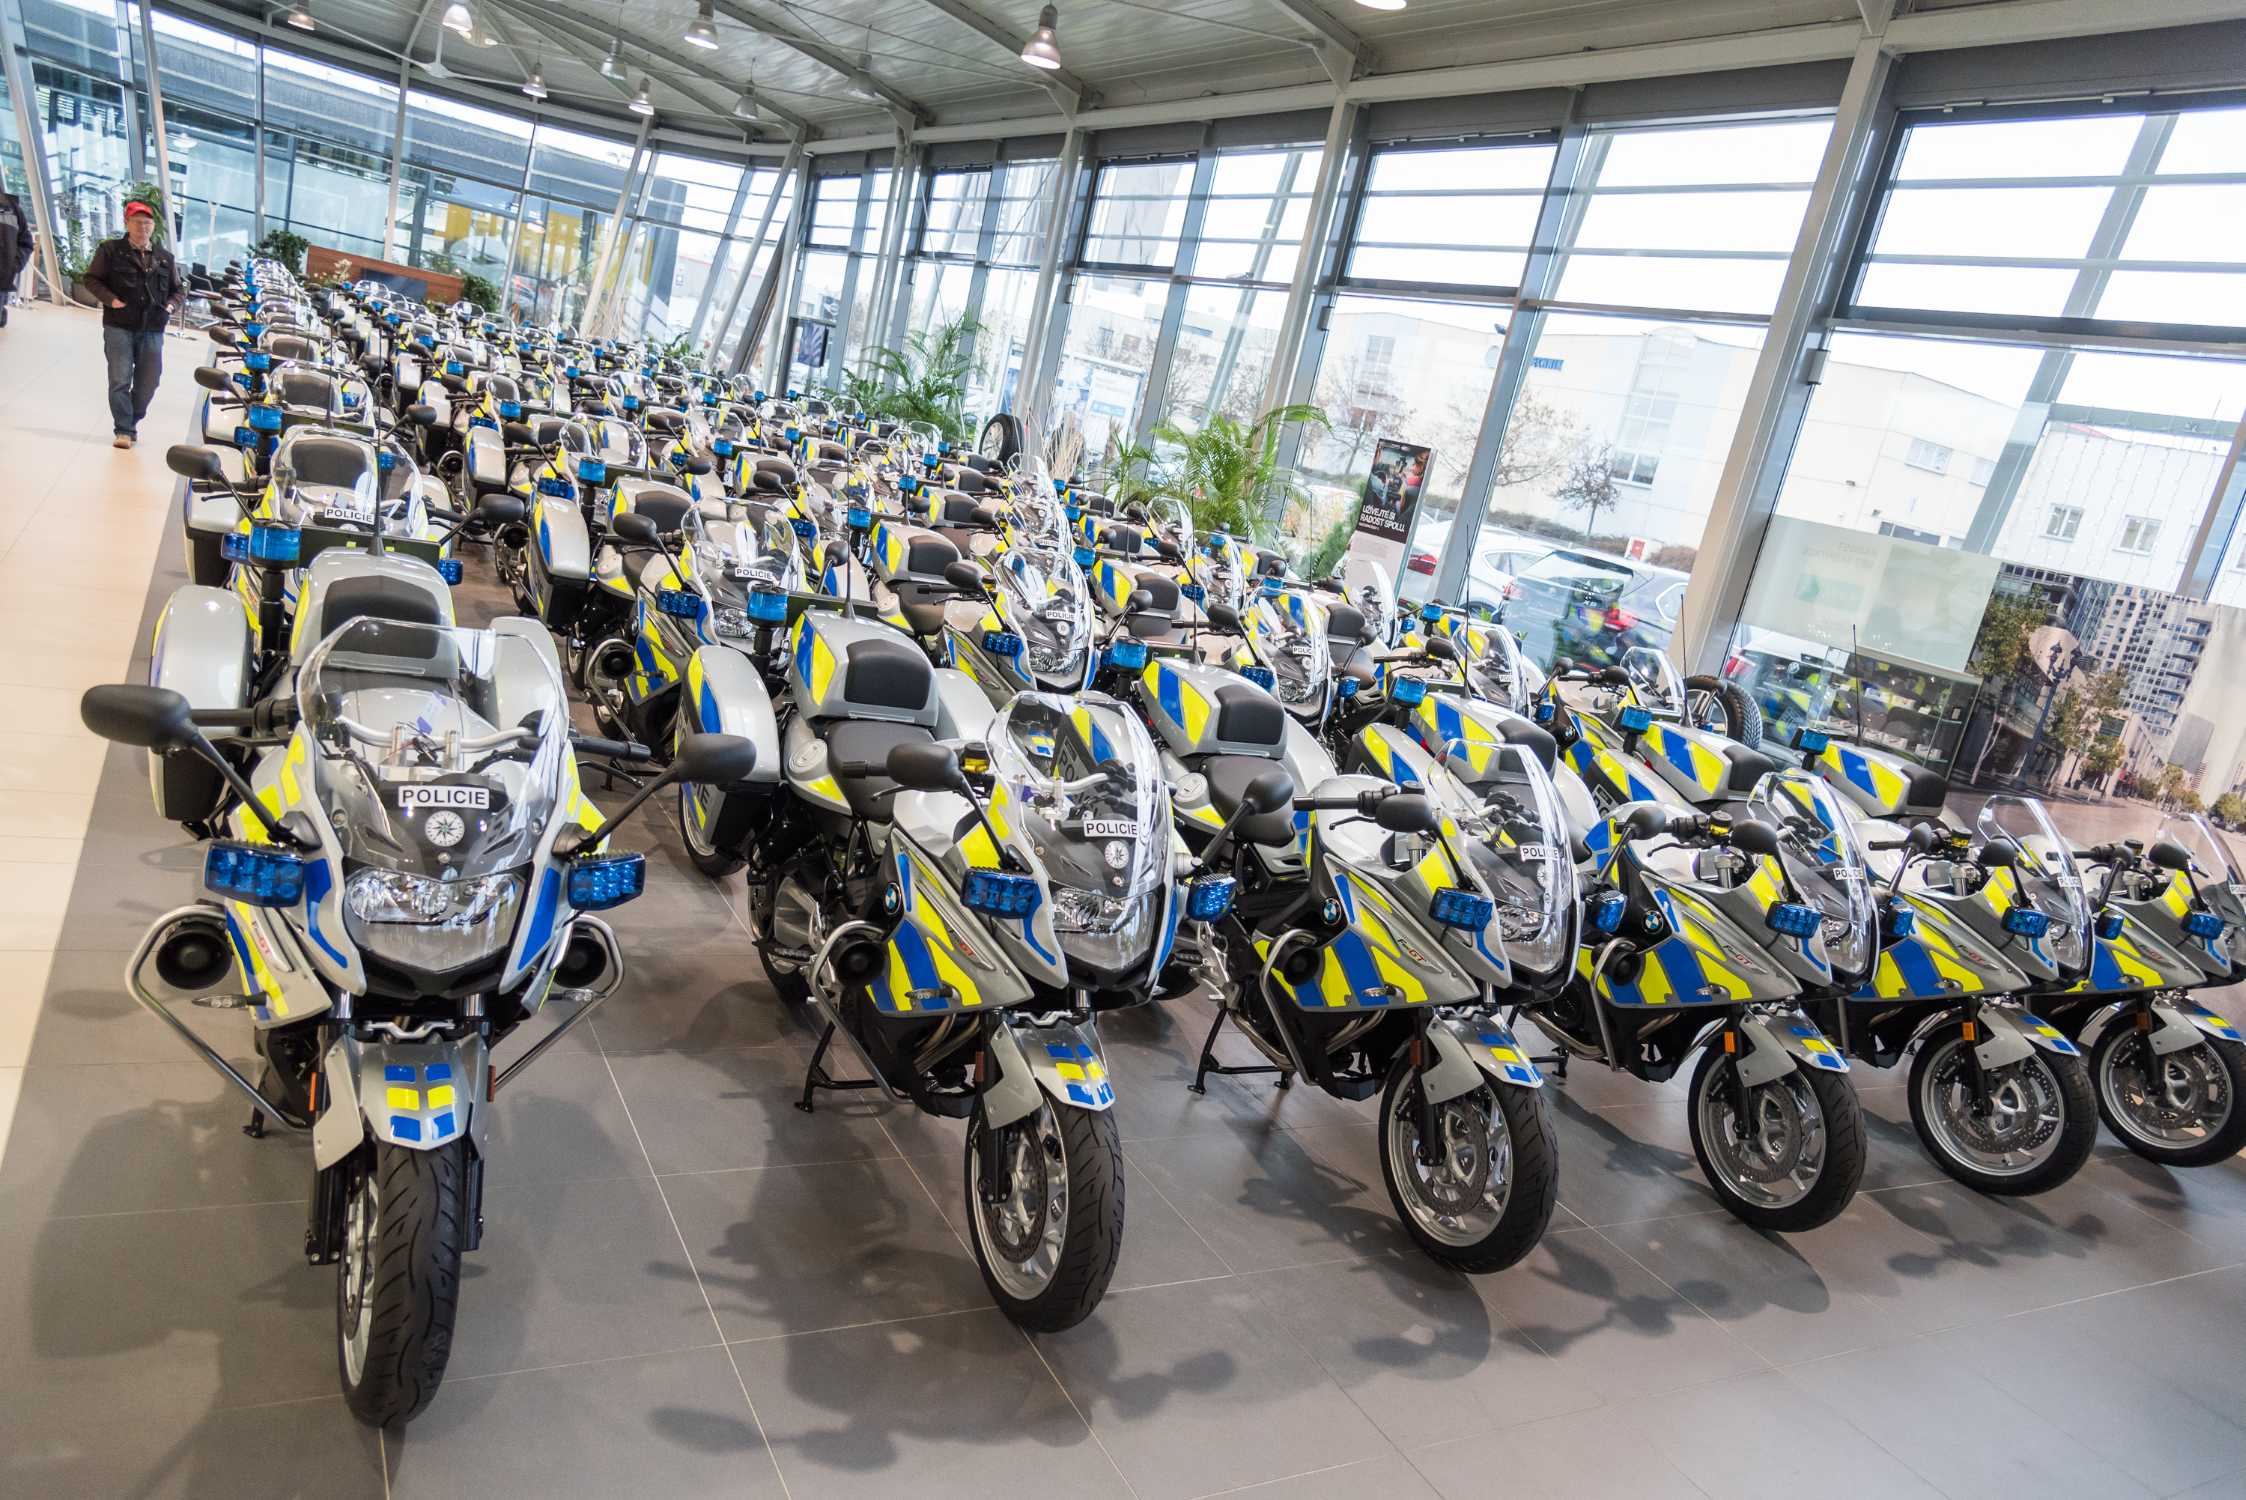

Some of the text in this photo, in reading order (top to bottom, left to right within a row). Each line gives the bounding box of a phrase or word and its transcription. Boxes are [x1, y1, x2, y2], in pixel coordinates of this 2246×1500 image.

[326, 508, 373, 523] POLICIE
[1360, 514, 1386, 527] RADOST
[736, 568, 773, 580] POLICIE
[402, 789, 486, 805] POLICIE
[1086, 822, 1137, 836] POLICIE
